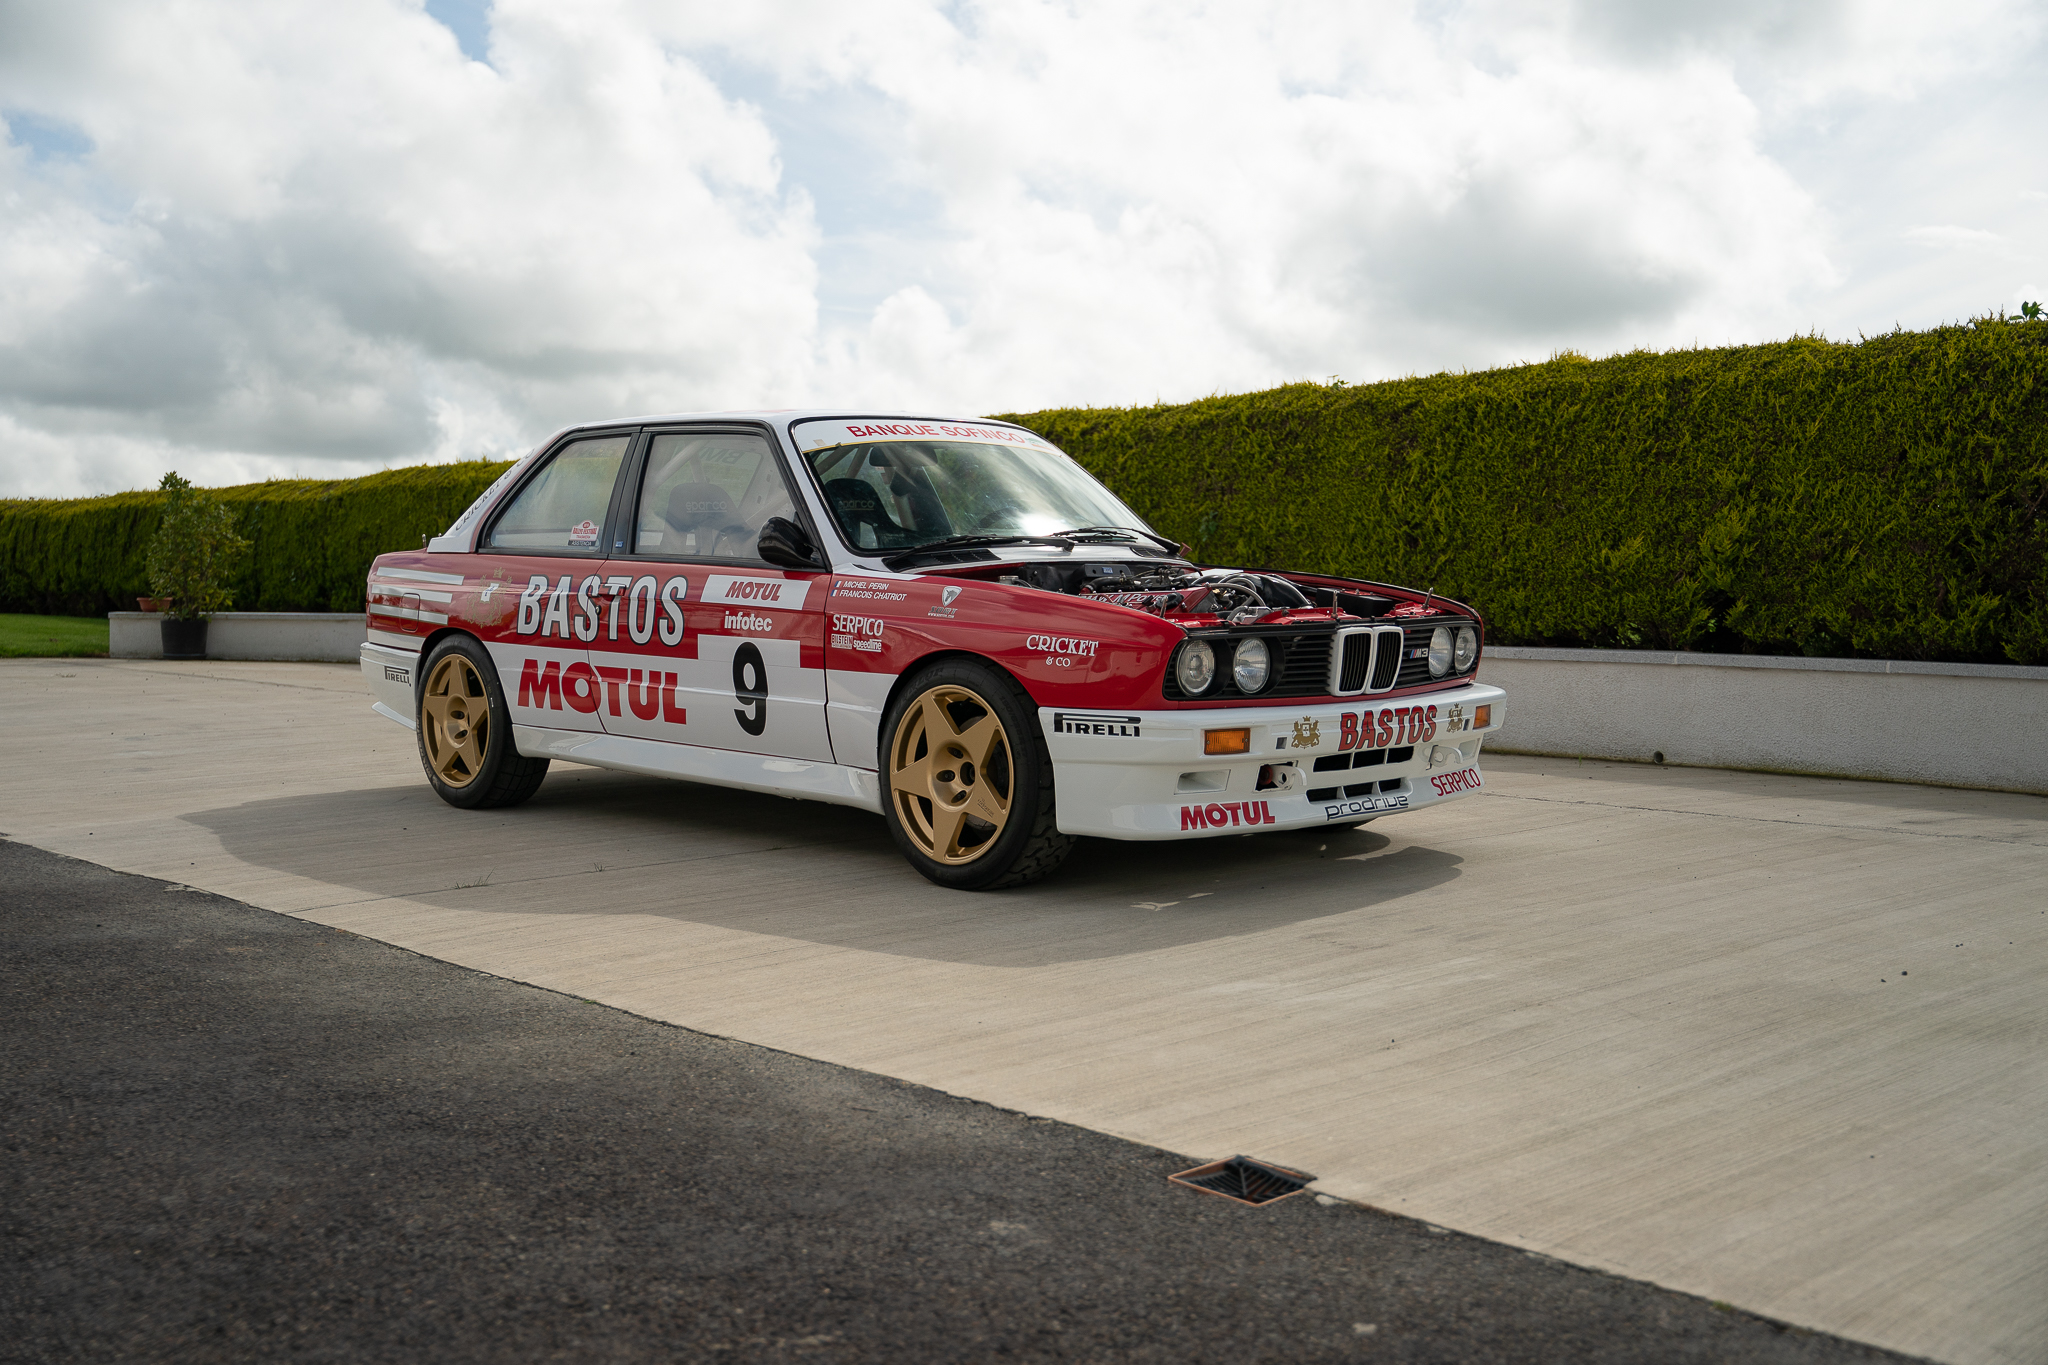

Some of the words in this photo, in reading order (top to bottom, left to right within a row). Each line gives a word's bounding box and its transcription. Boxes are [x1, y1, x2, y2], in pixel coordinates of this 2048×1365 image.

[846, 424, 940, 438] BANQUE
[940, 425, 1026, 444] SOFINCO
[685, 501, 727, 513] sparco
[725, 581, 782, 601] MOTUL
[839, 590, 873, 599] FRANCOIS
[874, 592, 907, 602] CHATRIOT
[843, 581, 867, 590] MICHEL
[868, 582, 889, 591] PERIN
[516, 574, 689, 647] BASTOS
[724, 611, 772, 631] infotec
[832, 614, 884, 636] SERPICO
[831, 634, 853, 645] BILSTEIN
[853, 639, 882, 650] speedline
[1026, 634, 1099, 656] CRICKET
[1045, 656, 1055, 665] &
[1055, 657, 1071, 667] CO
[1413, 648, 1429, 658] M3
[384, 665, 410, 684] PIRELLI
[517, 659, 687, 725] MOTUL
[732, 641, 769, 736] 9
[1054, 712, 1141, 737] PIRELLI
[1338, 705, 1438, 751] BASTOS
[1430, 768, 1481, 796] SERPICO
[1181, 801, 1275, 831] MOTUL
[1325, 795, 1409, 821] prodrive
